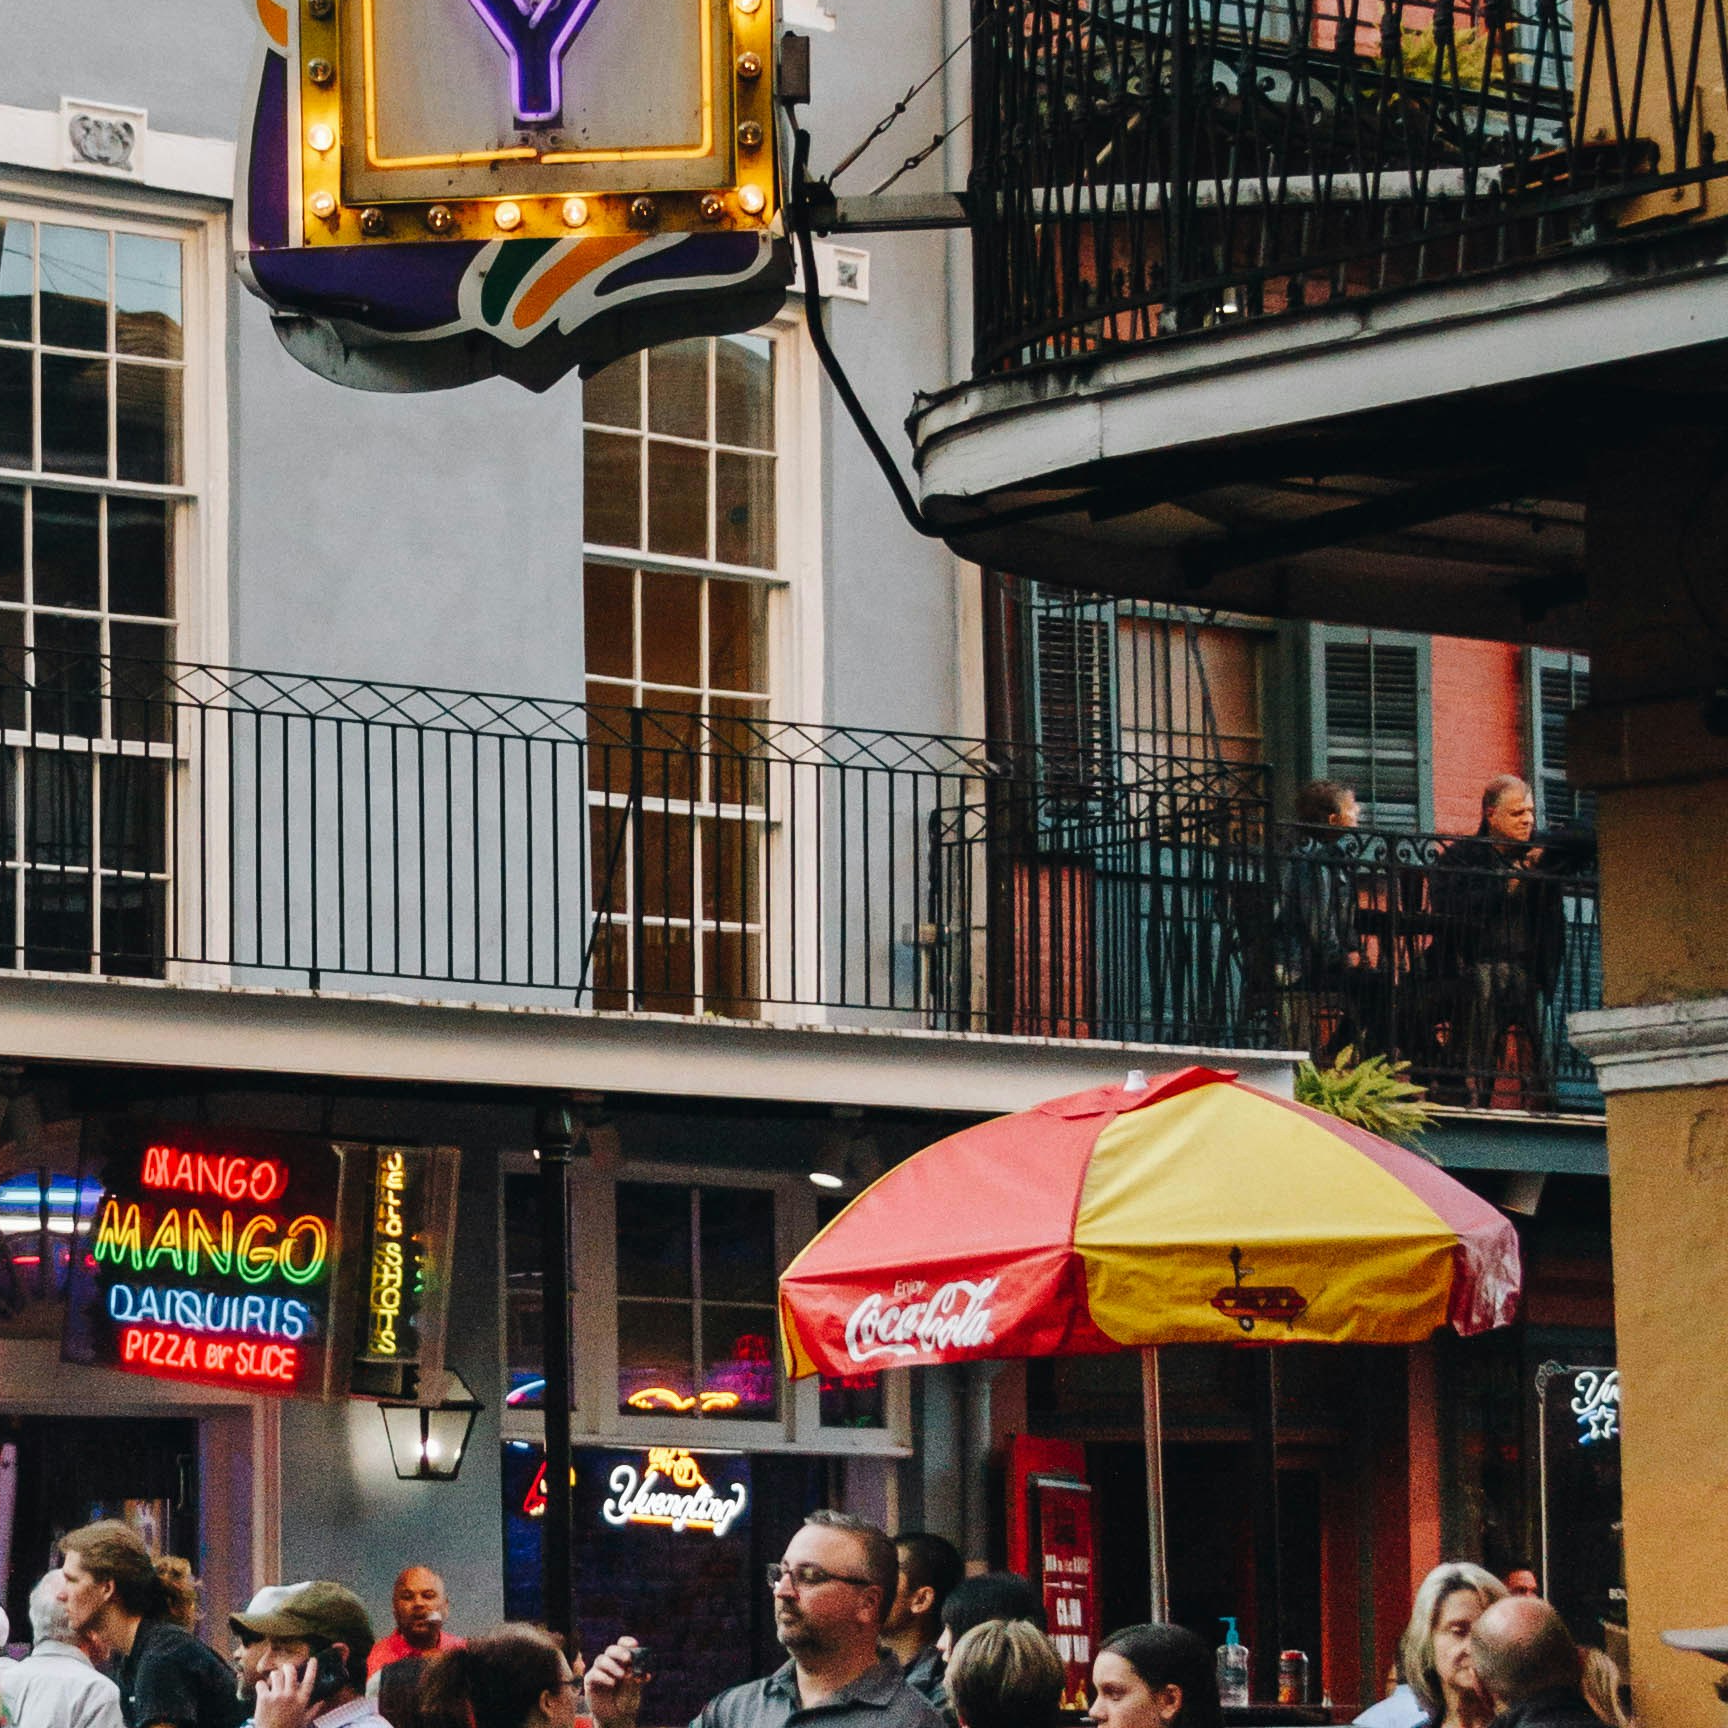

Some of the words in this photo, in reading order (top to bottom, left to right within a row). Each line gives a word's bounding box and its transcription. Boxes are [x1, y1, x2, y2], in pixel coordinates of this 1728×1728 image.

[143, 1147, 277, 1201] MANGO
[385, 1150, 404, 1237] JELLO
[94, 1200, 328, 1284] MANGO
[109, 1283, 309, 1341] DAIQUIRIS
[377, 1241, 404, 1355] SHOTS
[124, 1328, 198, 1369] PIZZA
[235, 1340, 297, 1381] SLICE
